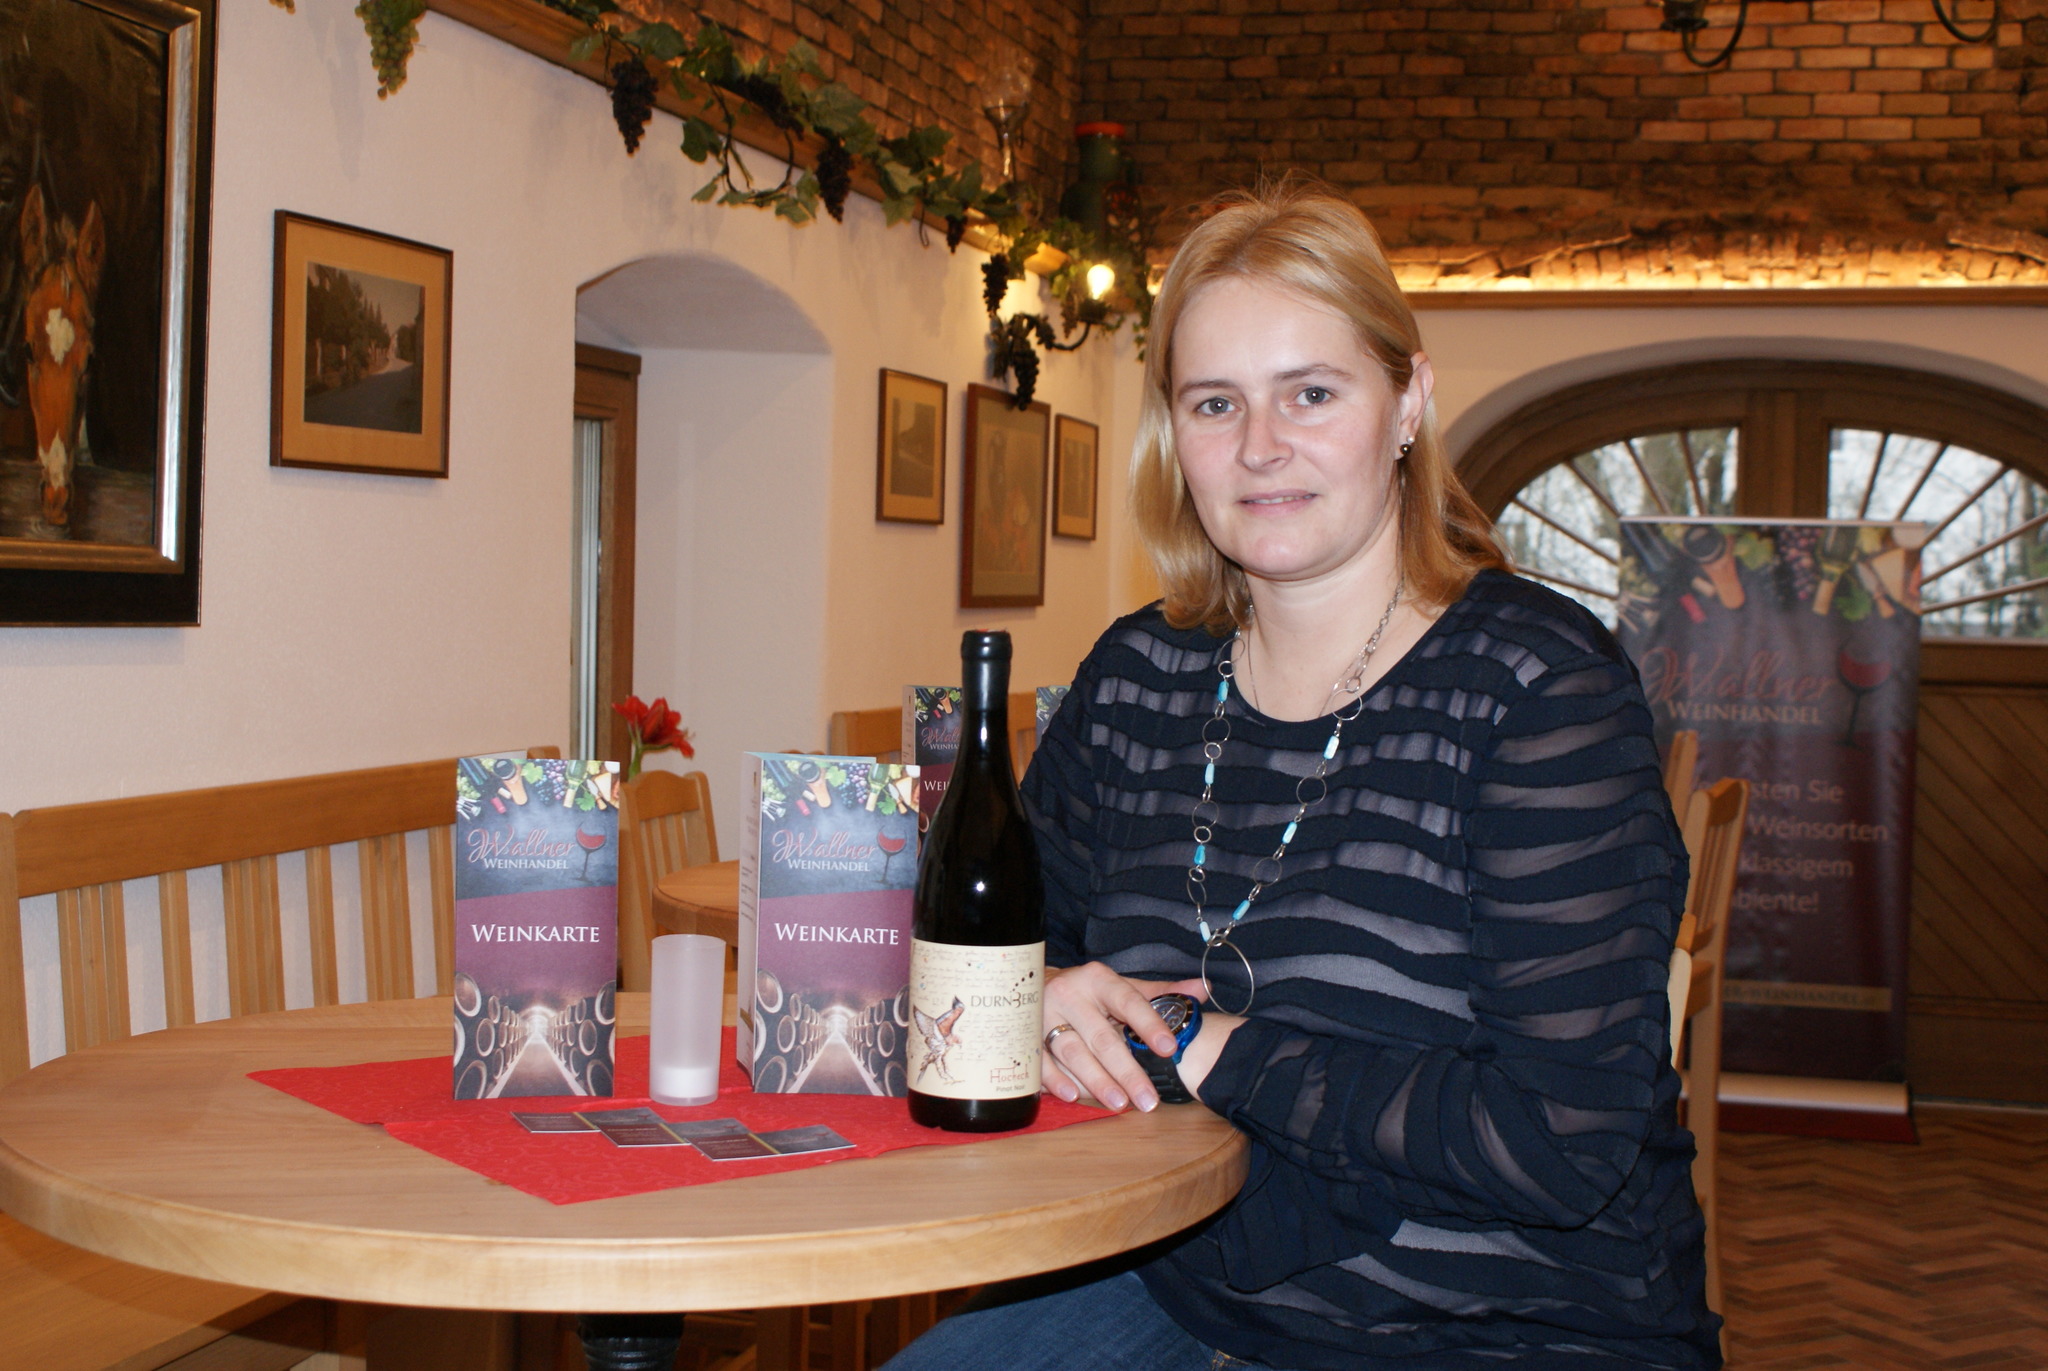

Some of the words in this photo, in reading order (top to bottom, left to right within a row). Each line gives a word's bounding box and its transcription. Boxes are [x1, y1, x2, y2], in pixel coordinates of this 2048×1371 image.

[1640, 646, 1838, 703] Wallner
[1668, 703, 1822, 725] WEINHANDEL
[921, 726, 961, 748] Wall
[929, 742, 960, 750] WEINHA
[1808, 780, 1844, 802] Sie
[467, 824, 576, 864] Wallner
[772, 826, 878, 864] Wallner
[484, 858, 568, 870] WEINHANDEL
[788, 859, 870, 872] WEINHANDEL
[471, 923, 600, 943] WEINKARTE
[774, 922, 899, 945] WEINKARTE
